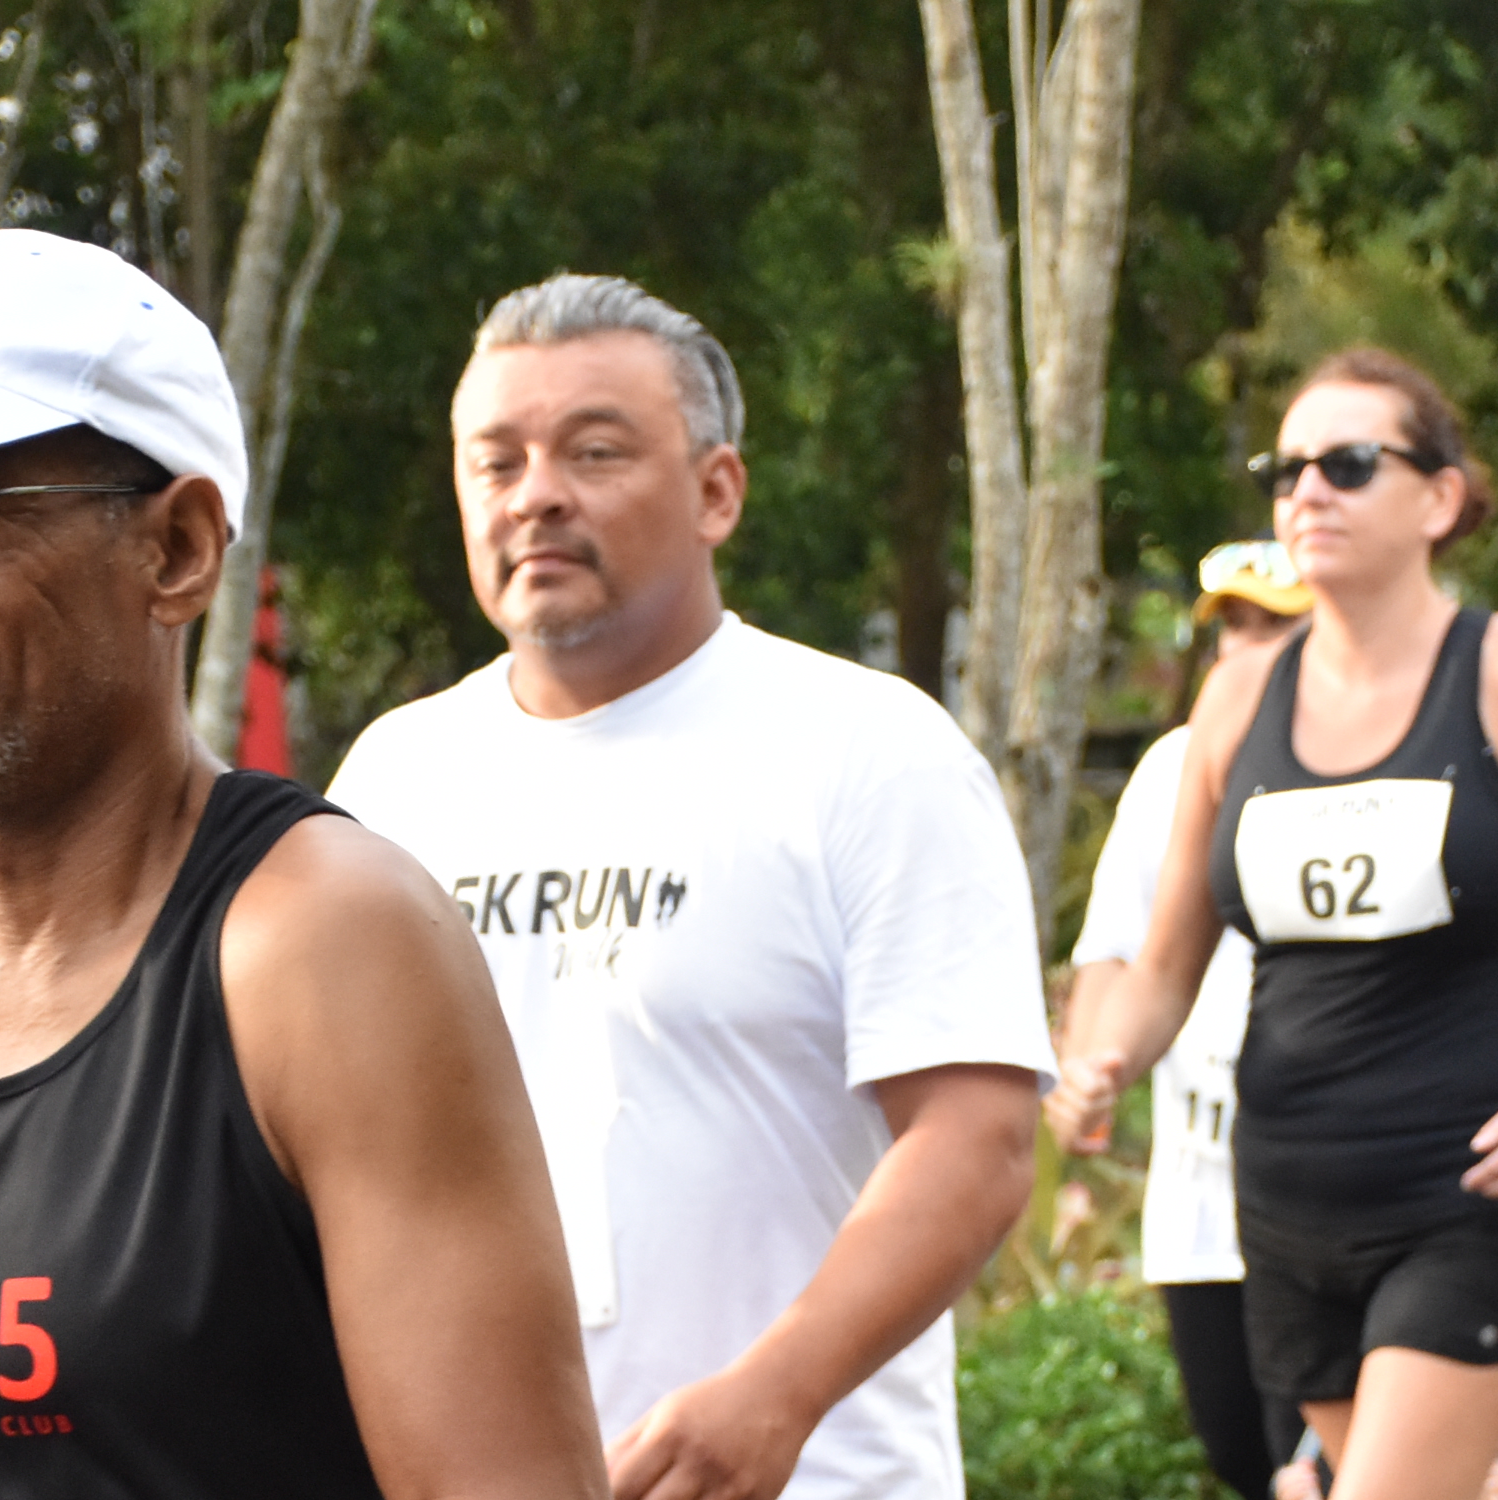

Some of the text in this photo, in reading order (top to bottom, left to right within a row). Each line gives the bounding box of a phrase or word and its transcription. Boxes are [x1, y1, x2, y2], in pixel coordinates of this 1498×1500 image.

[452, 867, 652, 935] 5K RUN
[1300, 853, 1380, 920] 62
[1, 1413, 74, 1437] CLUB
